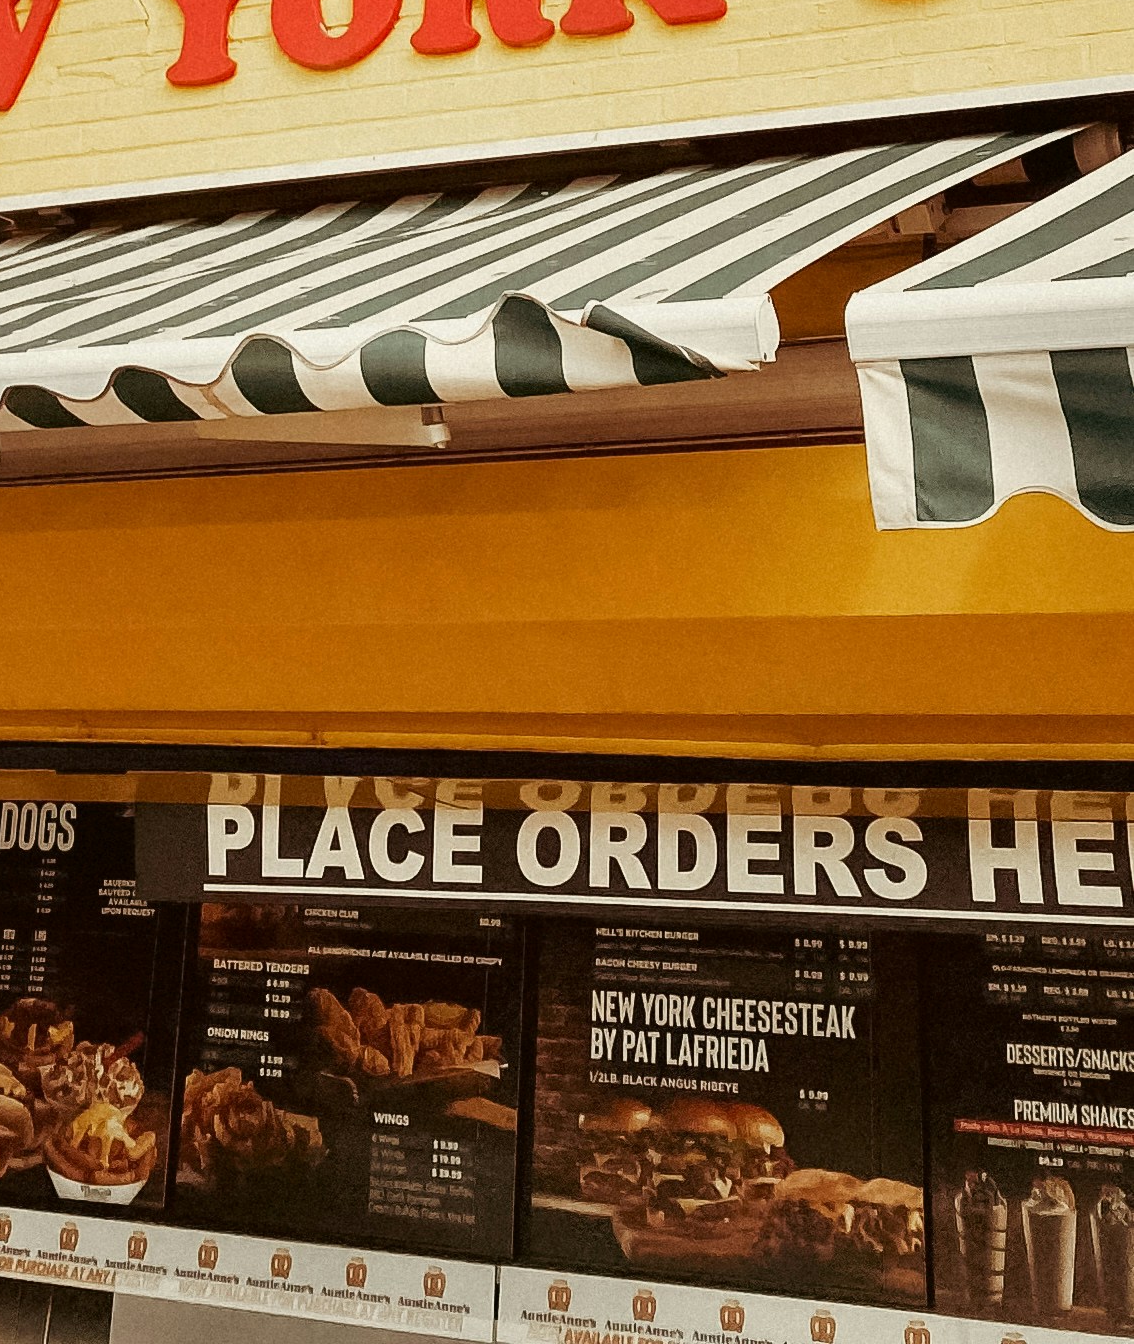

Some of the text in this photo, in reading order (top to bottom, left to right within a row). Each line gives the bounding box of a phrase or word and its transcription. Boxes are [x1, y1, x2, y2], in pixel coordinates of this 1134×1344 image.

[206, 803, 1134, 909] PLACE ORDERS HE
[213, 958, 310, 975] BATTERED TENDERS
[590, 989, 857, 1041] NEW YORK CHEESESTEAK
[207, 1027, 270, 1042] ONION RINGS
[590, 1027, 771, 1074] BY PAT LAFRIEDA
[622, 1075, 658, 1088] BLACK
[660, 1077, 698, 1091] ANGUS
[700, 1081, 740, 1095] RIBEYE
[373, 1111, 410, 1127] WINGS
[1013, 1099, 1134, 1130] PREMIUM SHAKES
[16, 1258, 69, 1279] PURCHASE
